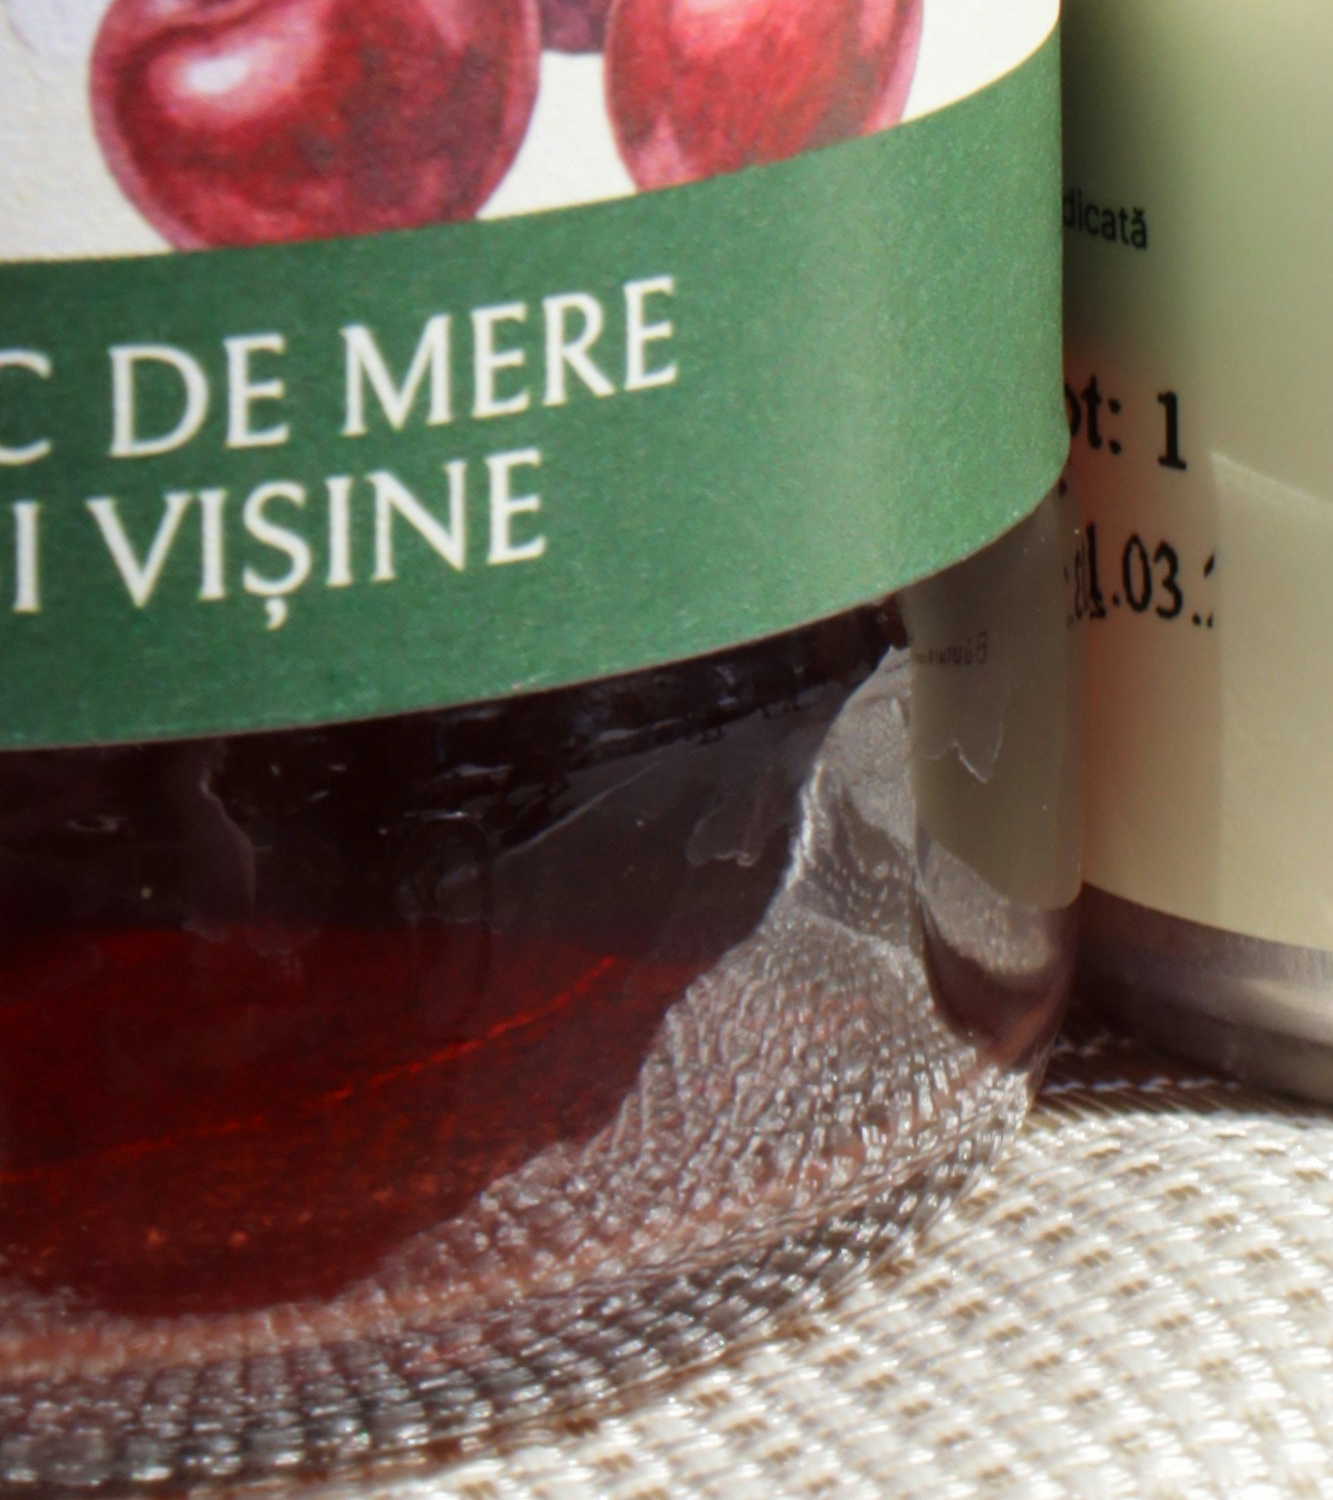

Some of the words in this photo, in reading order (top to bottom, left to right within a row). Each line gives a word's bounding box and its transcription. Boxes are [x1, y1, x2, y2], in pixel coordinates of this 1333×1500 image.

[108, 331, 291, 458] DE
[340, 274, 679, 438] MERE
[86, 447, 548, 631] VIȘINE
